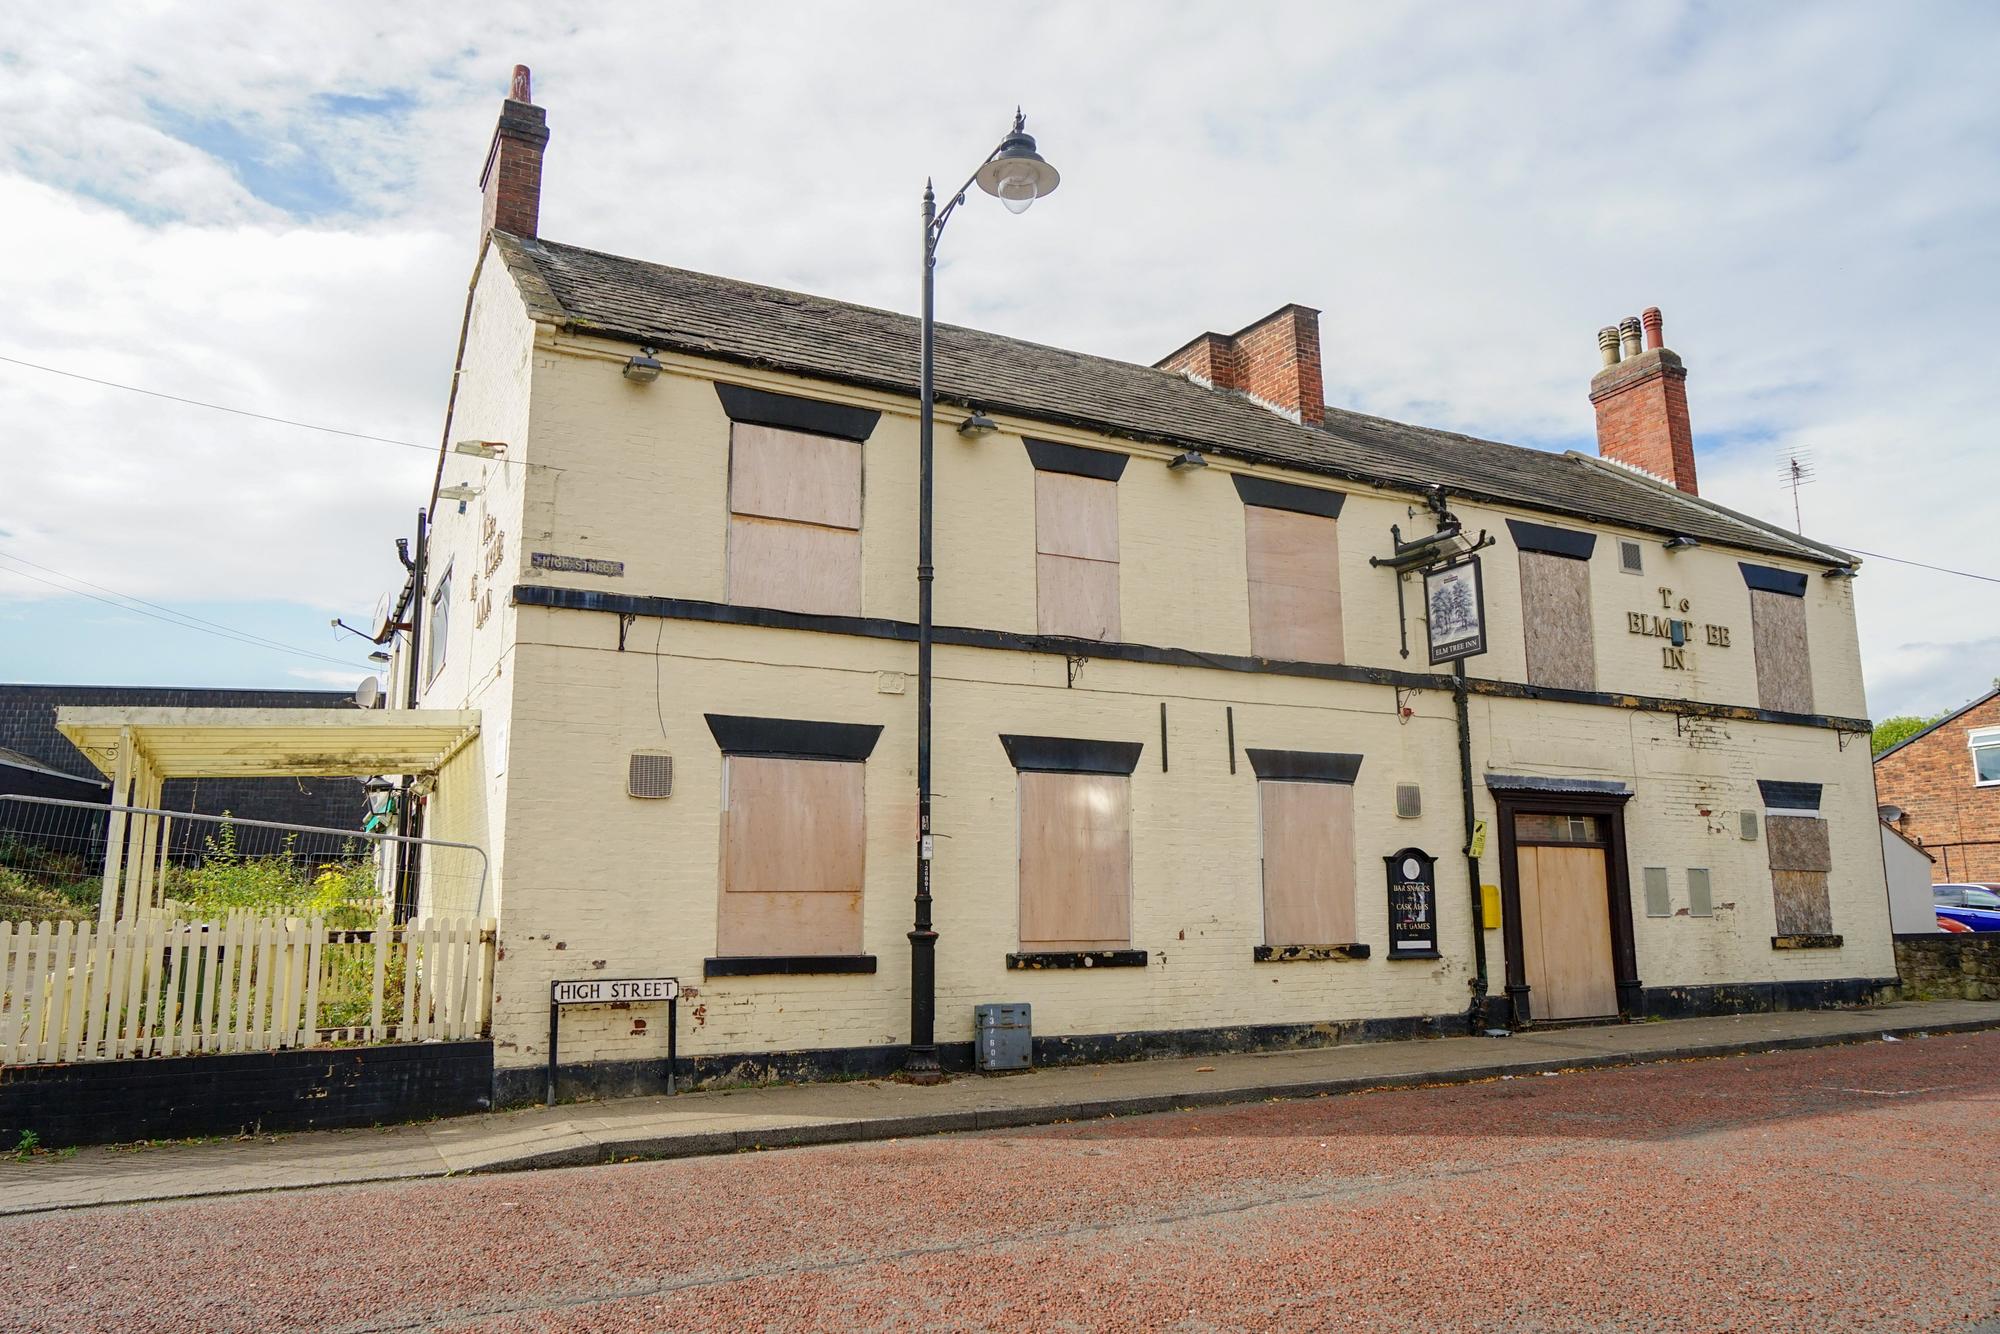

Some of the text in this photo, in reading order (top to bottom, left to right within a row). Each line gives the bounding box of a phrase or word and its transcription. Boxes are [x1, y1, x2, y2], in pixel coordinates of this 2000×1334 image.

[542, 556, 616, 574] HIGH STREET
[1628, 611, 1731, 647] ELM TEE
[1435, 640, 1478, 656] ELM TREE INN
[1393, 884, 1406, 892] BAR
[1396, 903, 1412, 911] CASK
[1409, 922, 1430, 930] GAMES
[560, 982, 673, 1000] HIGH STREET
